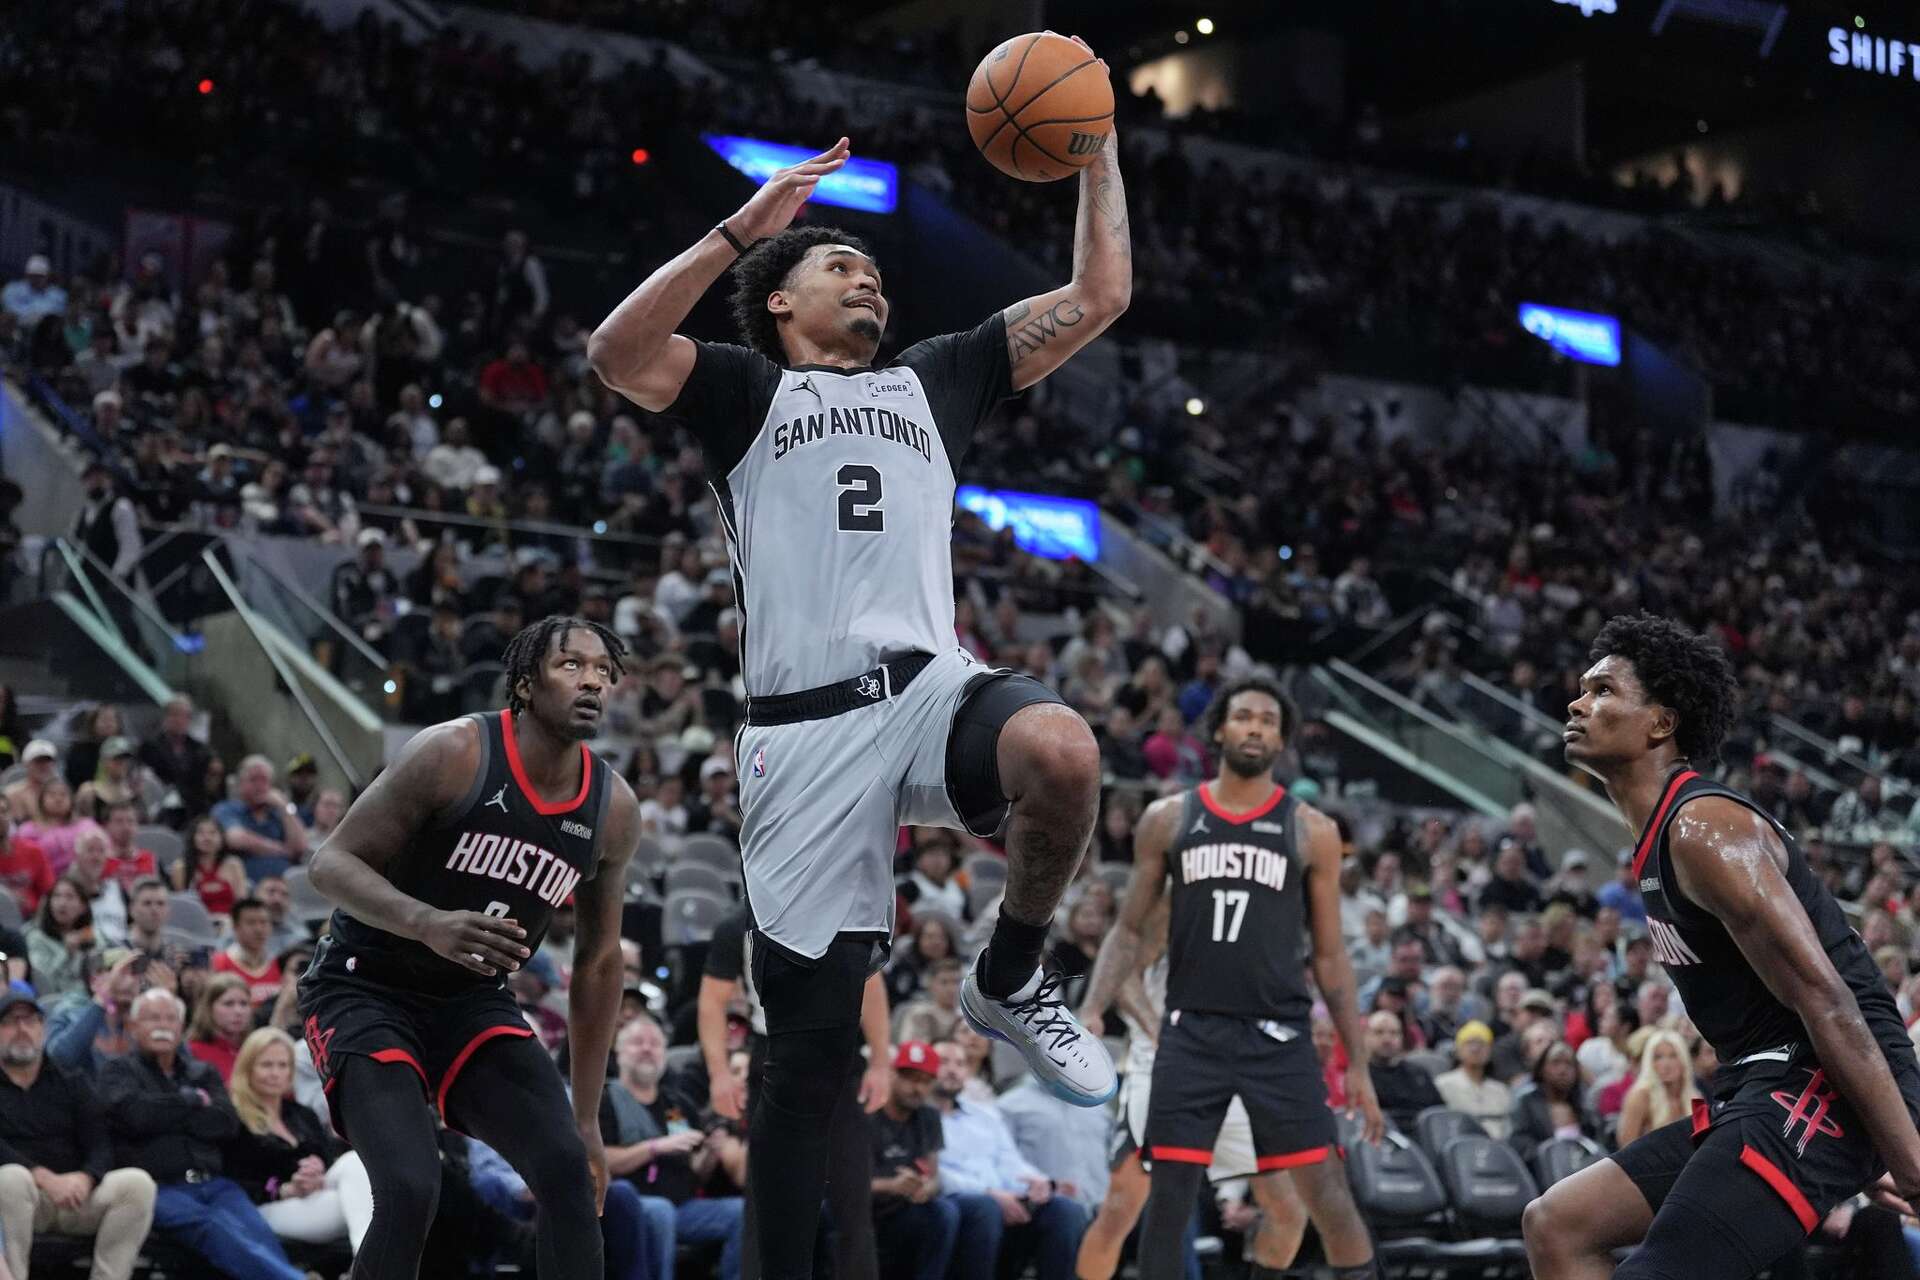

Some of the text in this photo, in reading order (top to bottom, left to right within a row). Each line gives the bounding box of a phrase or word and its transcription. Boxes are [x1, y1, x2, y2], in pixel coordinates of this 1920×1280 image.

[1008, 300, 1084, 367] AWG
[875, 384, 908, 393] LEDGER
[773, 406, 932, 464] SAN ANTONIO
[836, 463, 885, 533] 2
[445, 832, 582, 909] HOUSTON
[1181, 842, 1288, 892] HOUSTON
[1211, 889, 1250, 943] 17
